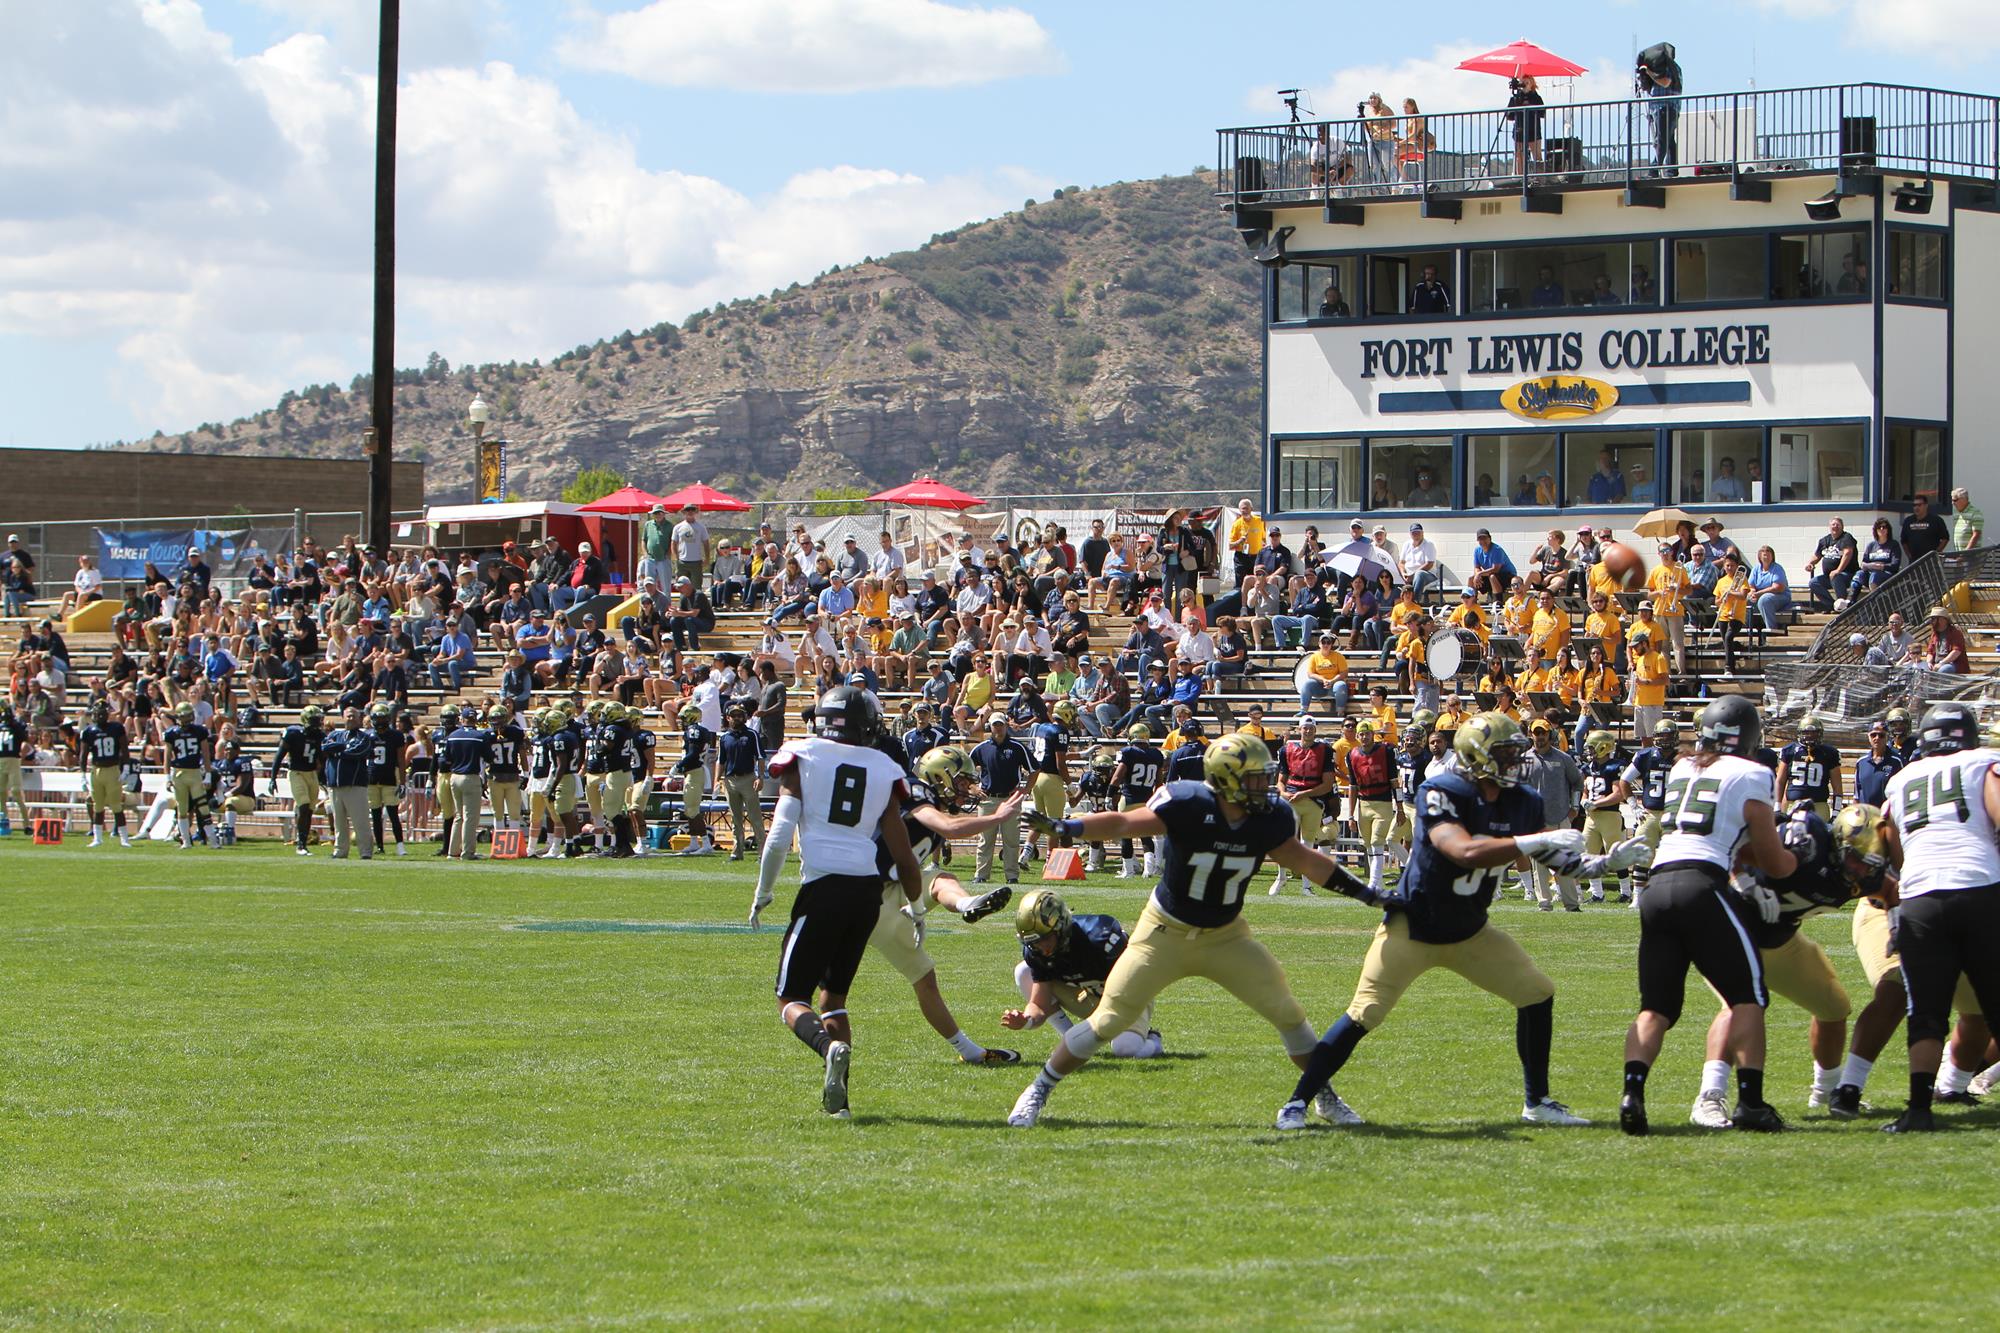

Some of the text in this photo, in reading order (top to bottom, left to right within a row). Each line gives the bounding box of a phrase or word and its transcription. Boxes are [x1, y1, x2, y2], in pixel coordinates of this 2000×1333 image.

[1360, 324, 1771, 379] FORT LEWIS COLLEGE
[1117, 525, 1158, 536] BREWING
[94, 736, 115, 757] 18
[174, 738, 199, 760] 35
[374, 746, 386, 765] 9
[491, 742, 515, 765] 37
[1131, 763, 1158, 788] 20
[1791, 761, 1824, 787] 50
[828, 763, 867, 828] 8
[1903, 765, 1970, 834] 94
[35, 820, 61, 842] 40
[493, 832, 521, 853] 50
[1047, 850, 1075, 877] 40
[1187, 852, 1257, 905] 17
